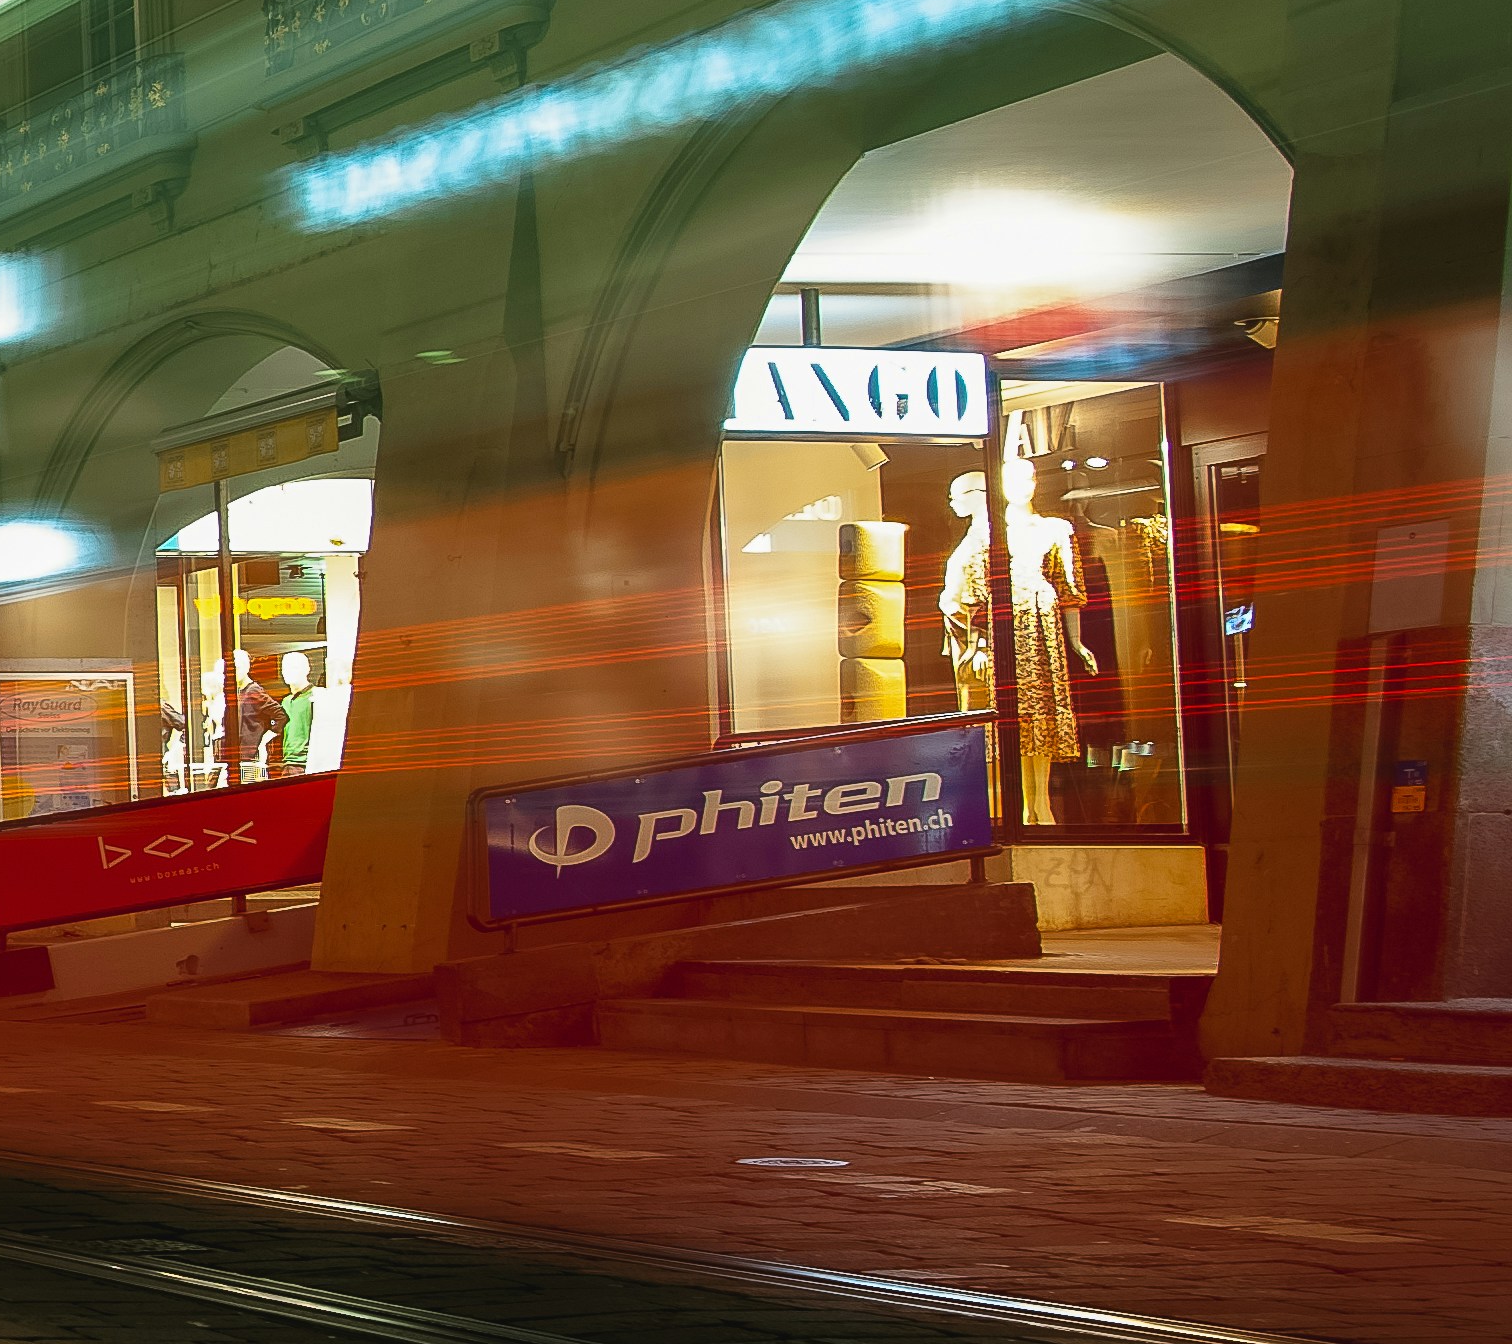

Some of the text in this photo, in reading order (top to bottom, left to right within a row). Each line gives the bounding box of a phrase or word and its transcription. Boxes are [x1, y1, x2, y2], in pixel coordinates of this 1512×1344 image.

[13, 698, 82, 713] RayGuard
[632, 771, 942, 864] phiten
[790, 809, 954, 850] www.phiten.ch
[97, 821, 257, 869] box
